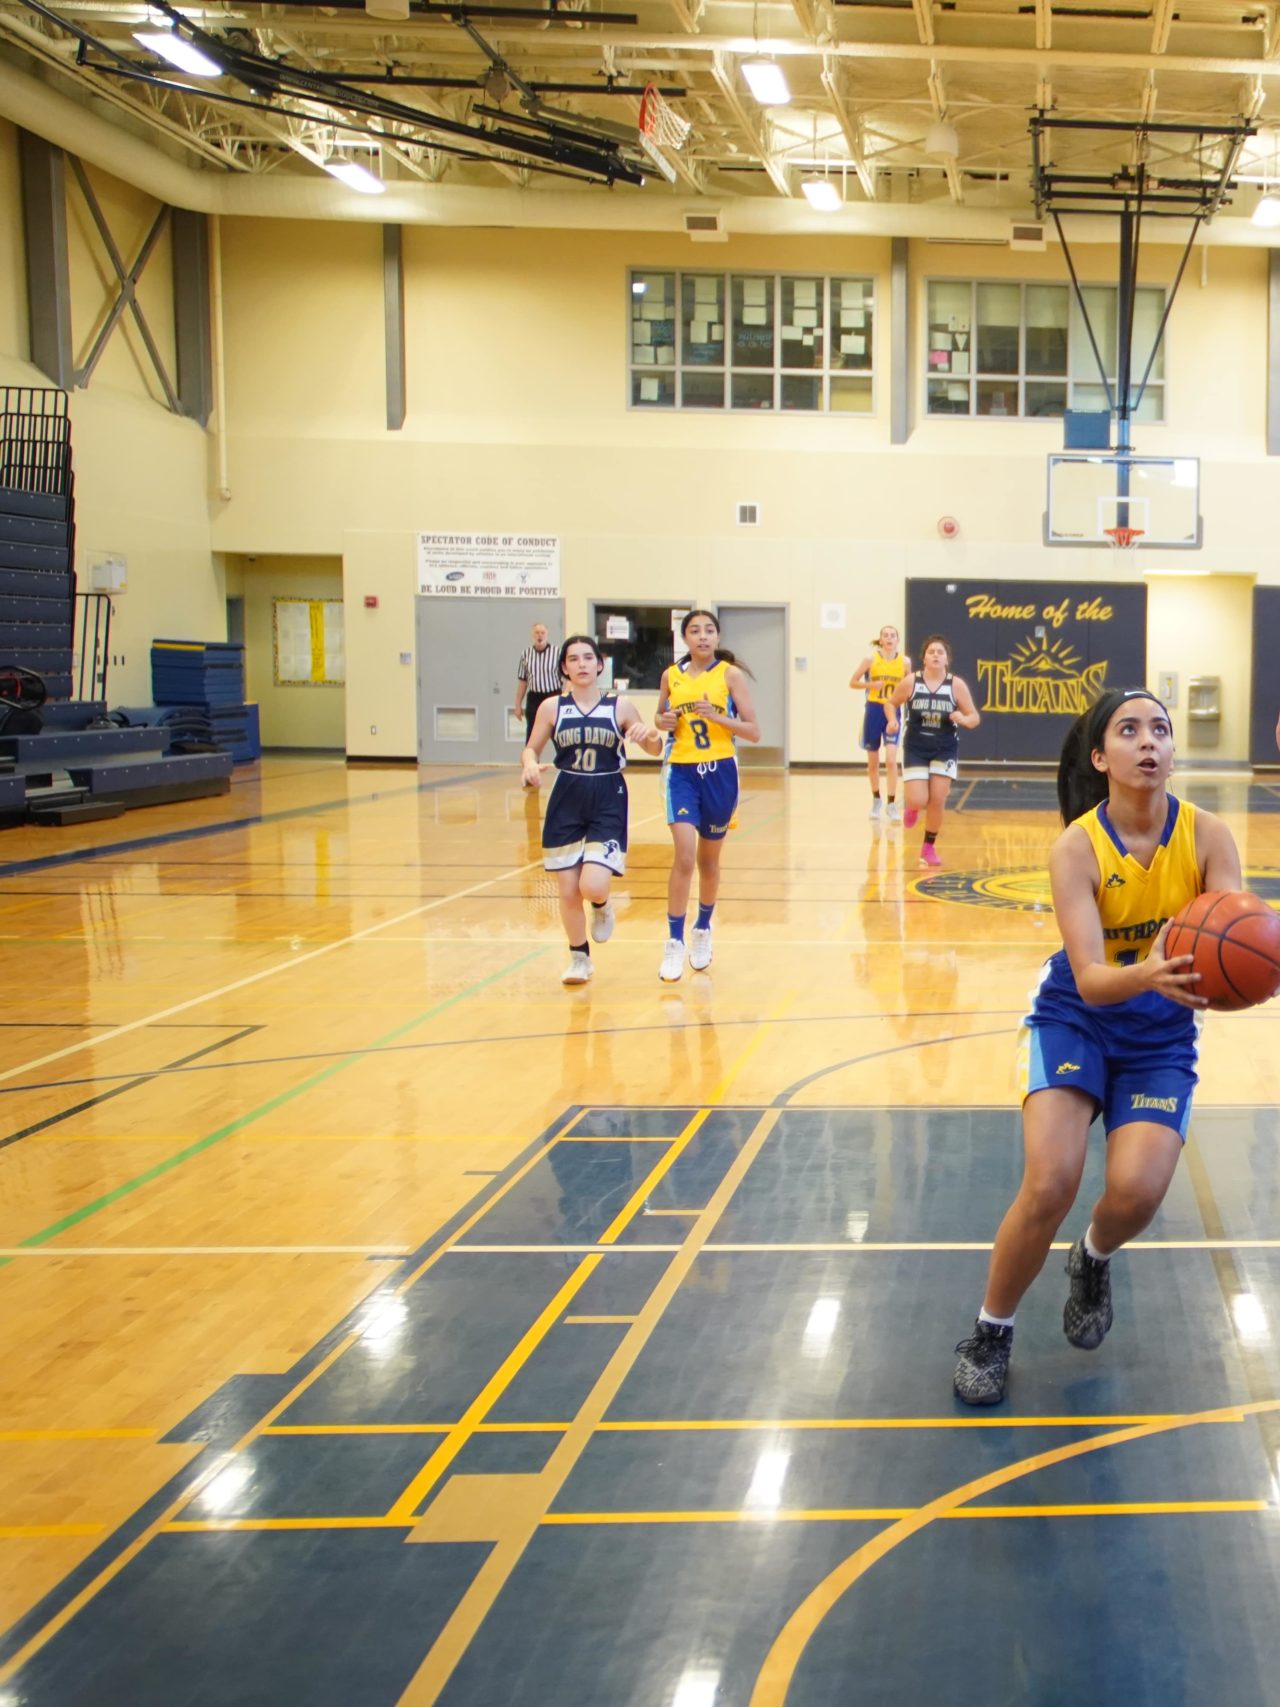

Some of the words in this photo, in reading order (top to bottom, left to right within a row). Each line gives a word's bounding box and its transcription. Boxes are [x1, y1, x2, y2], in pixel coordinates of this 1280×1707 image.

[420, 535, 472, 545] SPECTATOR
[475, 536, 499, 546] CODE
[502, 537, 514, 546] OF
[517, 537, 557, 547] CONDUCT
[420, 584, 433, 594] BE
[435, 584, 457, 594] LOUD
[460, 585, 472, 595] BE
[474, 585, 502, 596] PROUD
[505, 586, 517, 596] BE
[519, 587, 558, 596] POSITIVE
[965, 594, 1036, 620] Home
[1042, 598, 1070, 628] of
[1075, 596, 1114, 621] the
[976, 659, 1109, 716] TITANS
[911, 698, 930, 710] KING
[557, 727, 582, 749] KING
[584, 726, 616, 748] DAVID
[690, 718, 711, 750] 8
[571, 748, 597, 772] 10
[1130, 1093, 1178, 1113] TITANS
